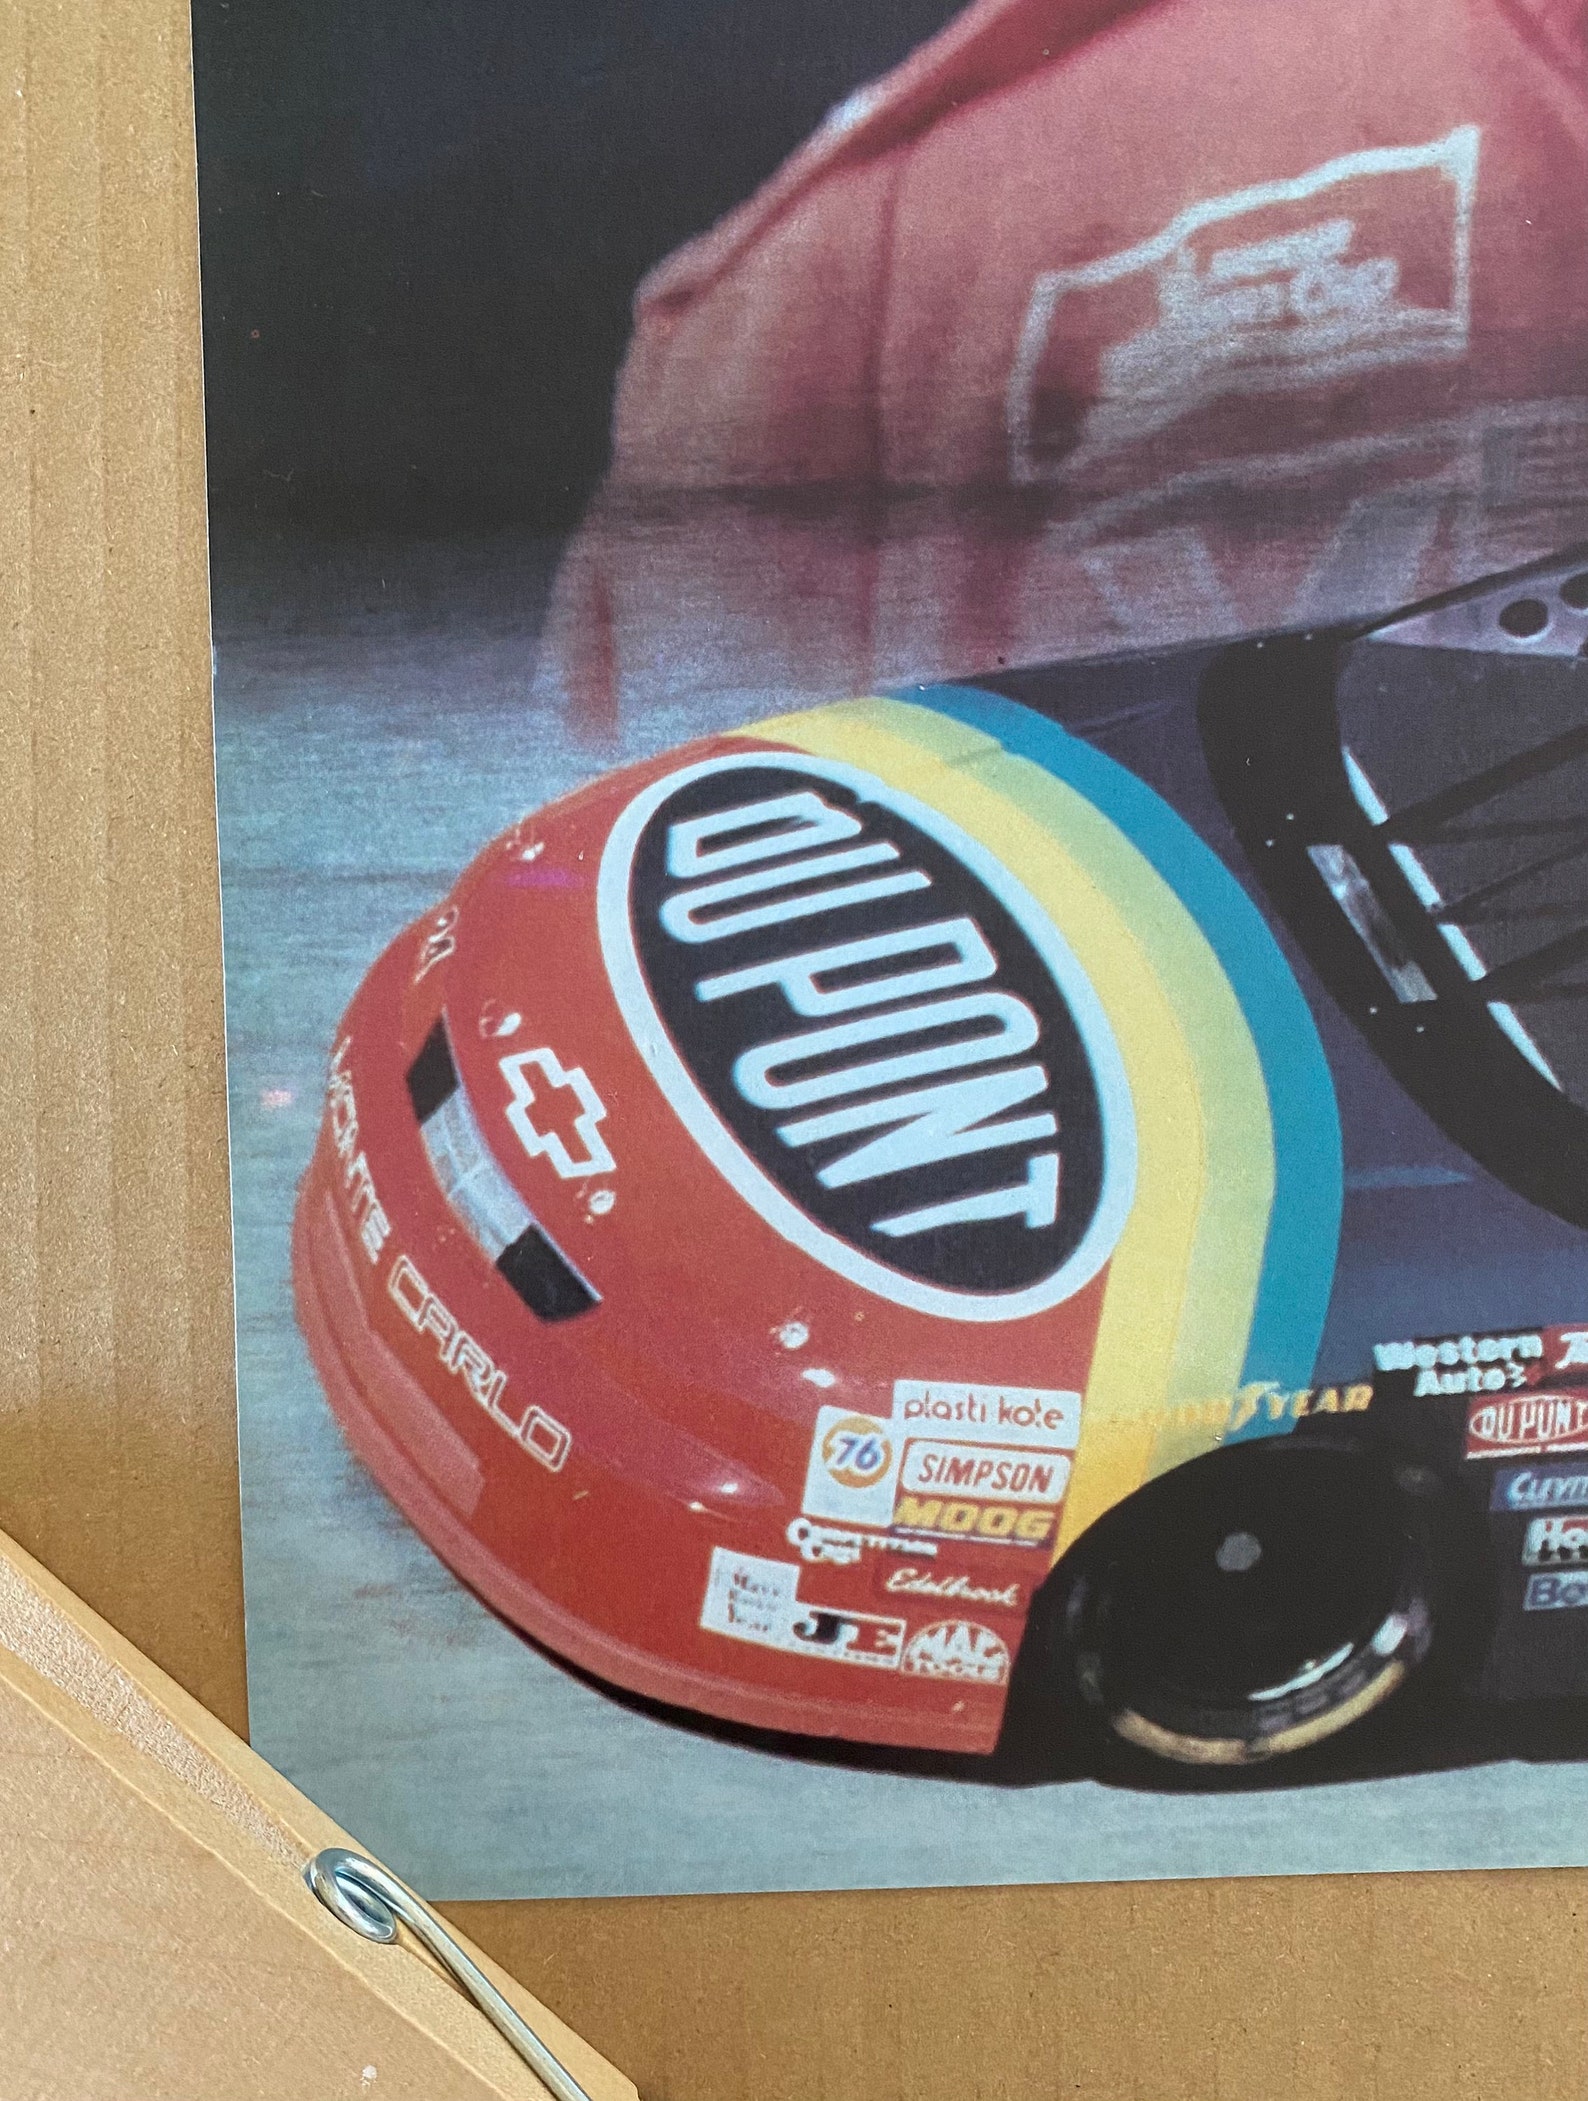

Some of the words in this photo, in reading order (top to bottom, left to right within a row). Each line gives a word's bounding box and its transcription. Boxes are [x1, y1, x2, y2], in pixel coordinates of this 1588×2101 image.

[660, 790, 1059, 1238] DUPONT
[388, 1254, 571, 1472] CARLO
[1374, 1335, 1543, 1371] Western
[904, 1391, 986, 1422] plasti
[836, 1438, 881, 1470] 76
[918, 1453, 1054, 1494] SIMPSON
[893, 1497, 1055, 1538] MOOG
